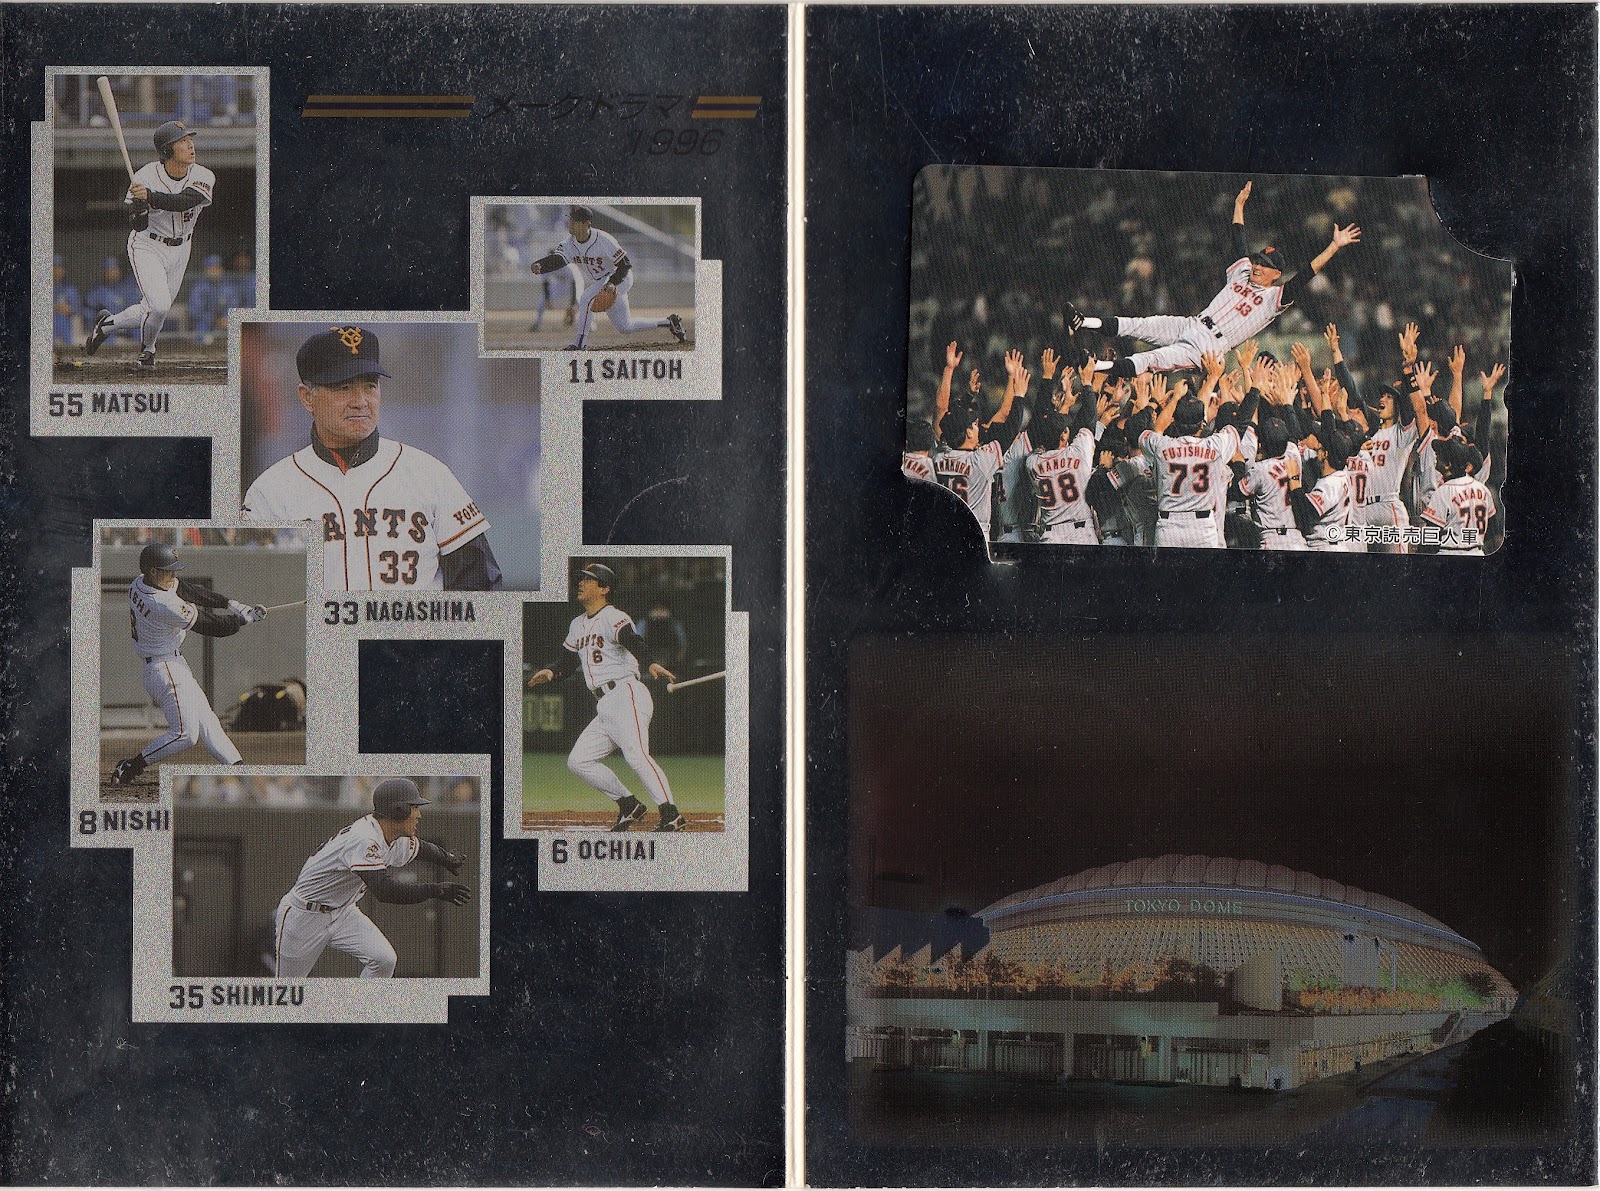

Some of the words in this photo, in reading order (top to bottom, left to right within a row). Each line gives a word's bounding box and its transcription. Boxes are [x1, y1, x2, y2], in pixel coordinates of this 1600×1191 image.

[482, 92, 684, 121] メークドラマ
[631, 128, 725, 156] 1996
[569, 358, 595, 383] 11
[601, 358, 683, 380] SAITOH
[49, 393, 84, 417] 55
[92, 393, 170, 413] MATSUI
[1162, 445, 1217, 462] FUJISHIRO
[1038, 472, 1080, 508] 98
[1168, 462, 1210, 495] 73
[1458, 504, 1487, 535] 78
[379, 550, 420, 585] 33
[324, 601, 359, 625] 33
[366, 601, 476, 622] NAGASHIMA
[592, 649, 603, 664] 6
[79, 810, 97, 835] 8
[104, 810, 169, 831] NISHI
[552, 839, 568, 864] 6
[579, 839, 656, 861] OCHIAI
[1125, 898, 1181, 913] TOKYO
[1190, 899, 1243, 915] DOME
[169, 985, 204, 1009] 35
[211, 984, 305, 1006] SHIMIZU
